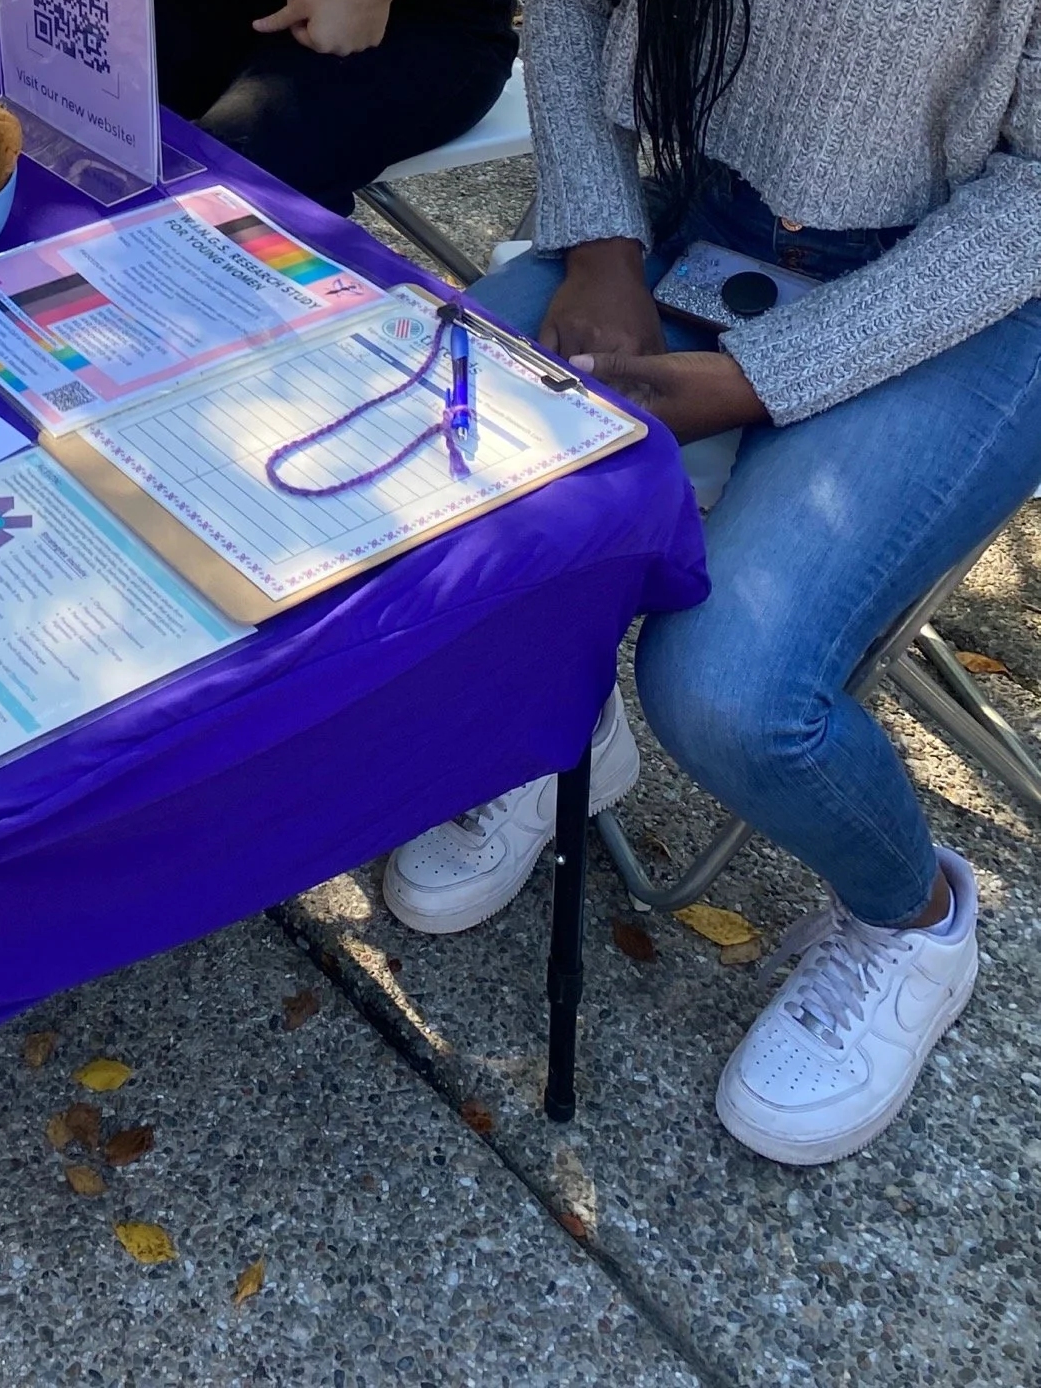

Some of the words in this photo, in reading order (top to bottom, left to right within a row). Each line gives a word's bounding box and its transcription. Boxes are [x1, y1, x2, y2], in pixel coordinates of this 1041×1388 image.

[17, 67, 39, 92] Visit
[41, 84, 59, 102] our
[61, 97, 85, 118] new
[88, 110, 136, 147] website!
[162, 219, 189, 236] FOR
[183, 235, 226, 264] YOUNG
[219, 262, 267, 291] WOMEN
[177, 214, 233, 253] W.I.N.G.S.
[227, 253, 286, 287] RESEARCH
[279, 285, 321, 310] STUDY
